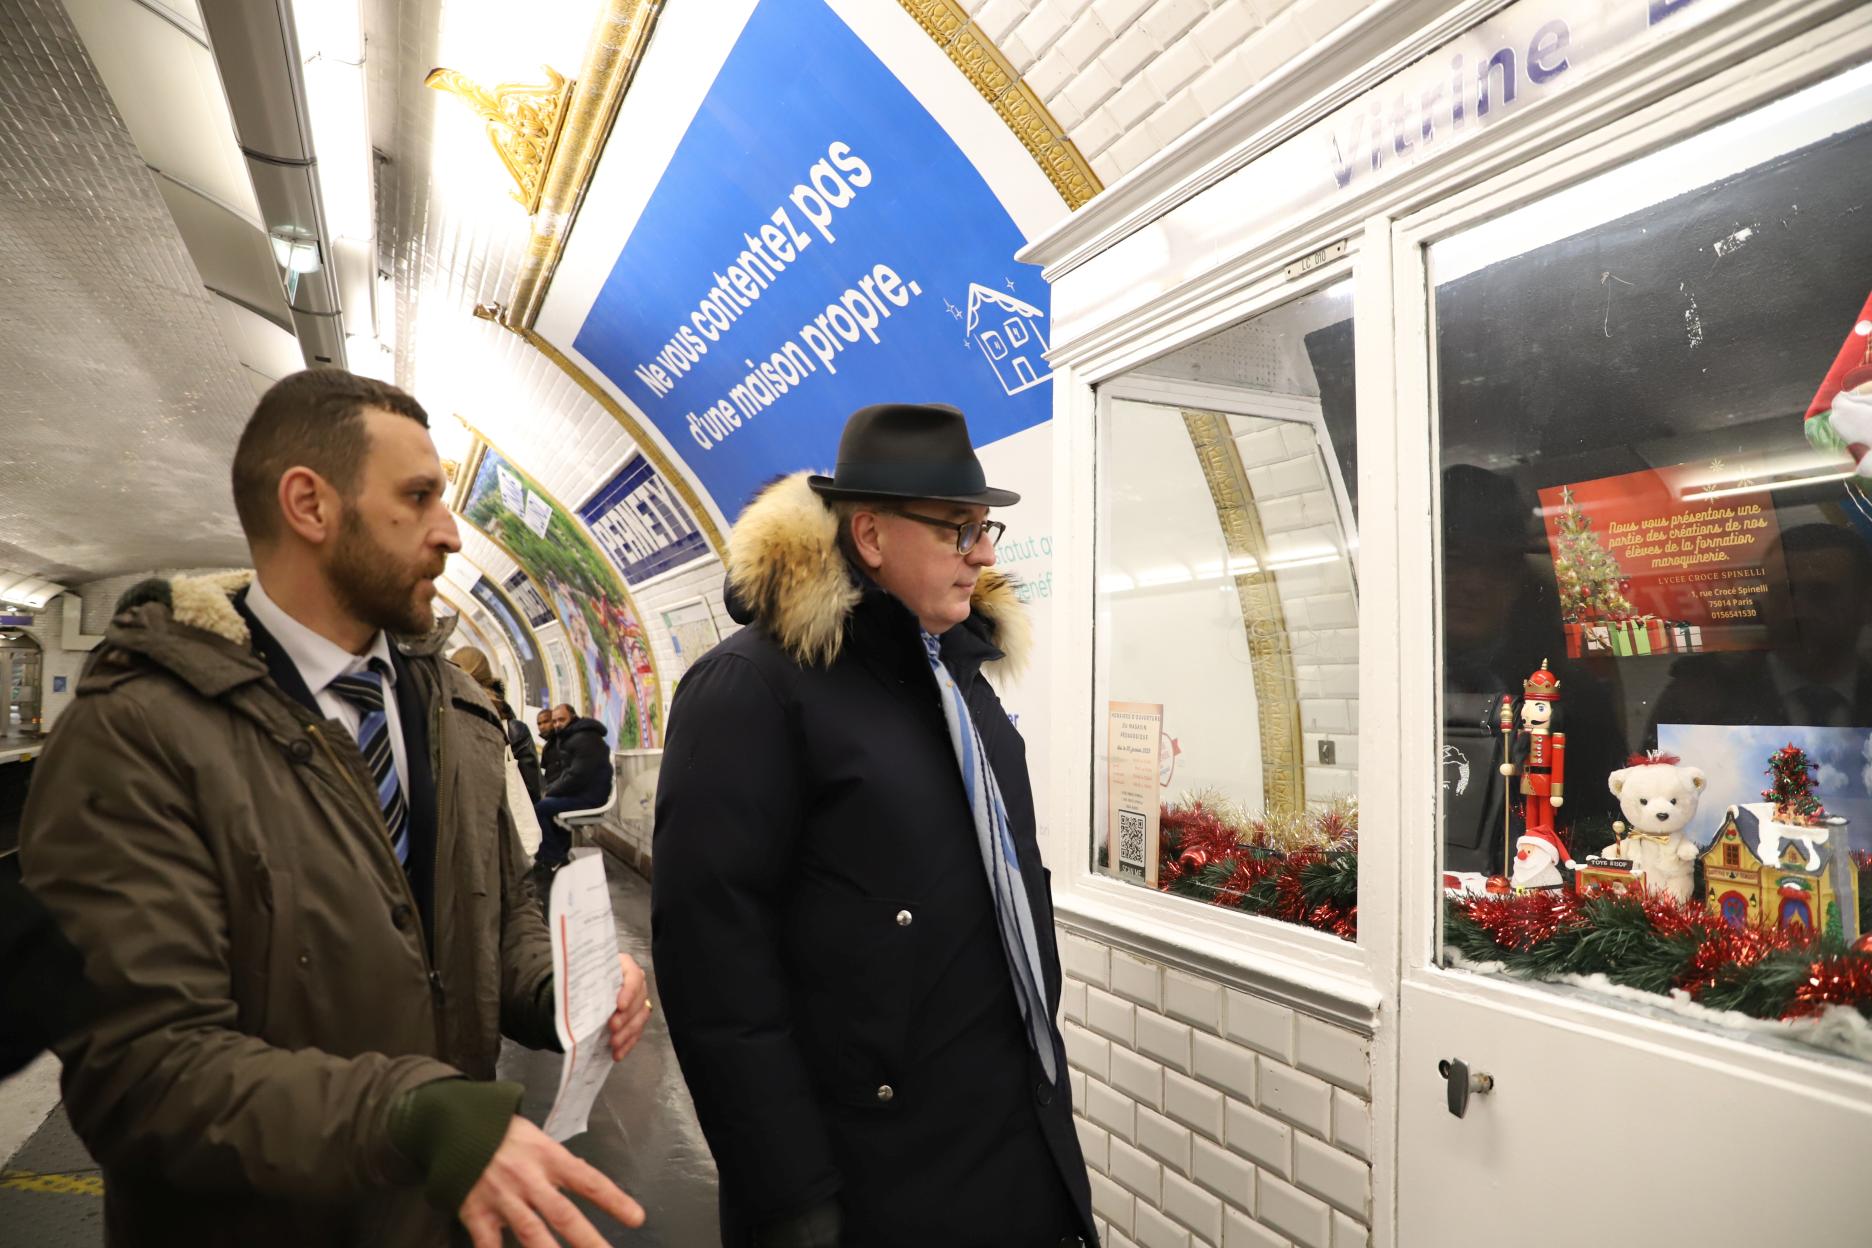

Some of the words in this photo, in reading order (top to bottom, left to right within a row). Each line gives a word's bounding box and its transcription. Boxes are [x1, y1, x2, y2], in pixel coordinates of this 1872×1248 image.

[1332, 18, 1571, 189] Vitrine
[634, 363, 674, 399] Ne
[656, 325, 708, 379] vous
[690, 206, 812, 342] contentez
[788, 140, 872, 244] pas
[685, 399, 742, 450] d'une
[728, 340, 817, 420] maison
[800, 263, 922, 375] propre.
[1608, 521, 1638, 534] Nous
[1641, 517, 1669, 529] vous
[1671, 507, 1736, 529] présentons
[1737, 504, 1761, 516] une
[1608, 533, 1644, 550] partie
[1646, 529, 1667, 541] des
[1669, 521, 1723, 539] créations
[1725, 517, 1741, 531] de
[1743, 517, 1768, 528] nos
[1625, 543, 1663, 559] élèves
[1664, 540, 1679, 553] de
[1681, 537, 1694, 551] la
[1694, 532, 1755, 555] formation
[1651, 549, 1730, 568] maroquinerie.
[1658, 575, 1687, 585] LYCEE
[1688, 572, 1719, 582] CROCE
[1721, 568, 1767, 579] SPINELLI
[1738, 584, 1769, 596] Spinelli
[1709, 599, 1732, 608] 75014
[1733, 598, 1753, 606] Paris
